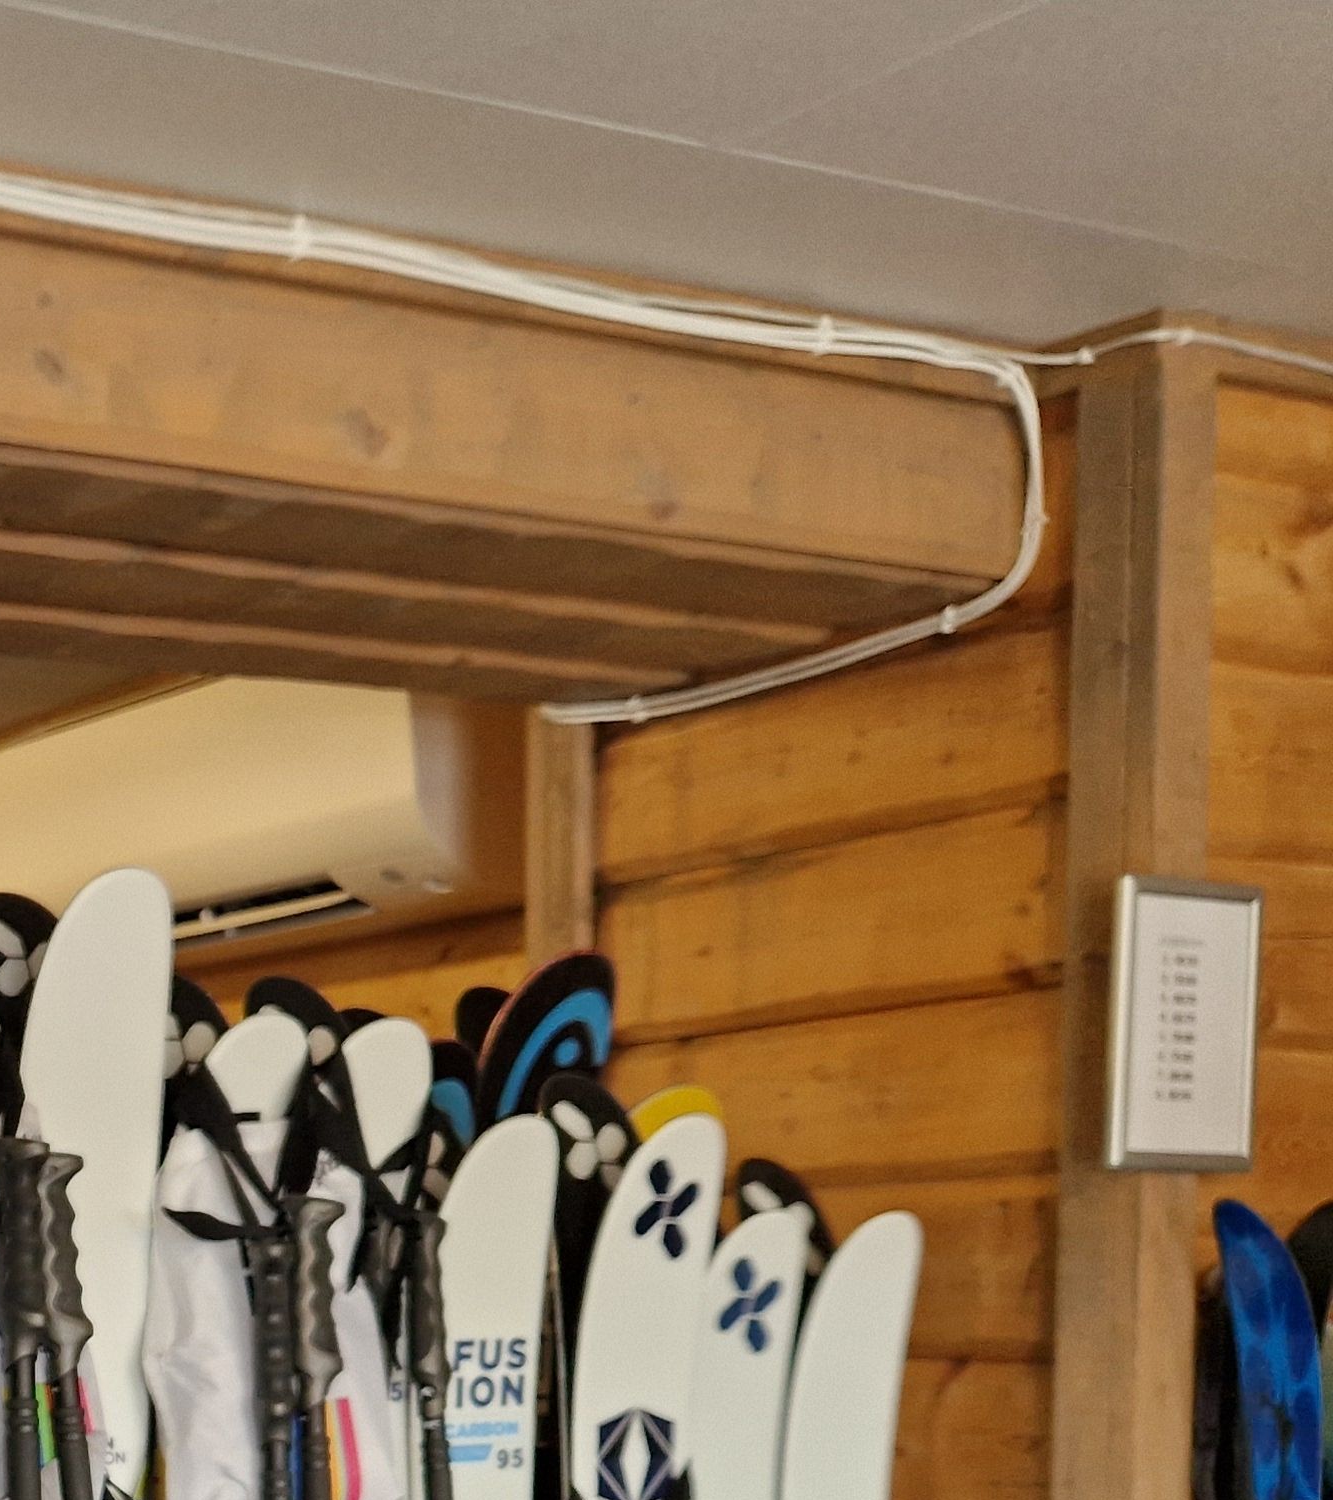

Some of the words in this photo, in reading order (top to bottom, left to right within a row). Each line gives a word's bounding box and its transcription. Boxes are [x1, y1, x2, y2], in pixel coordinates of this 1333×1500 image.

[453, 1338, 527, 1371] FUS
[455, 1376, 525, 1408] ION
[497, 1448, 524, 1468] 95
